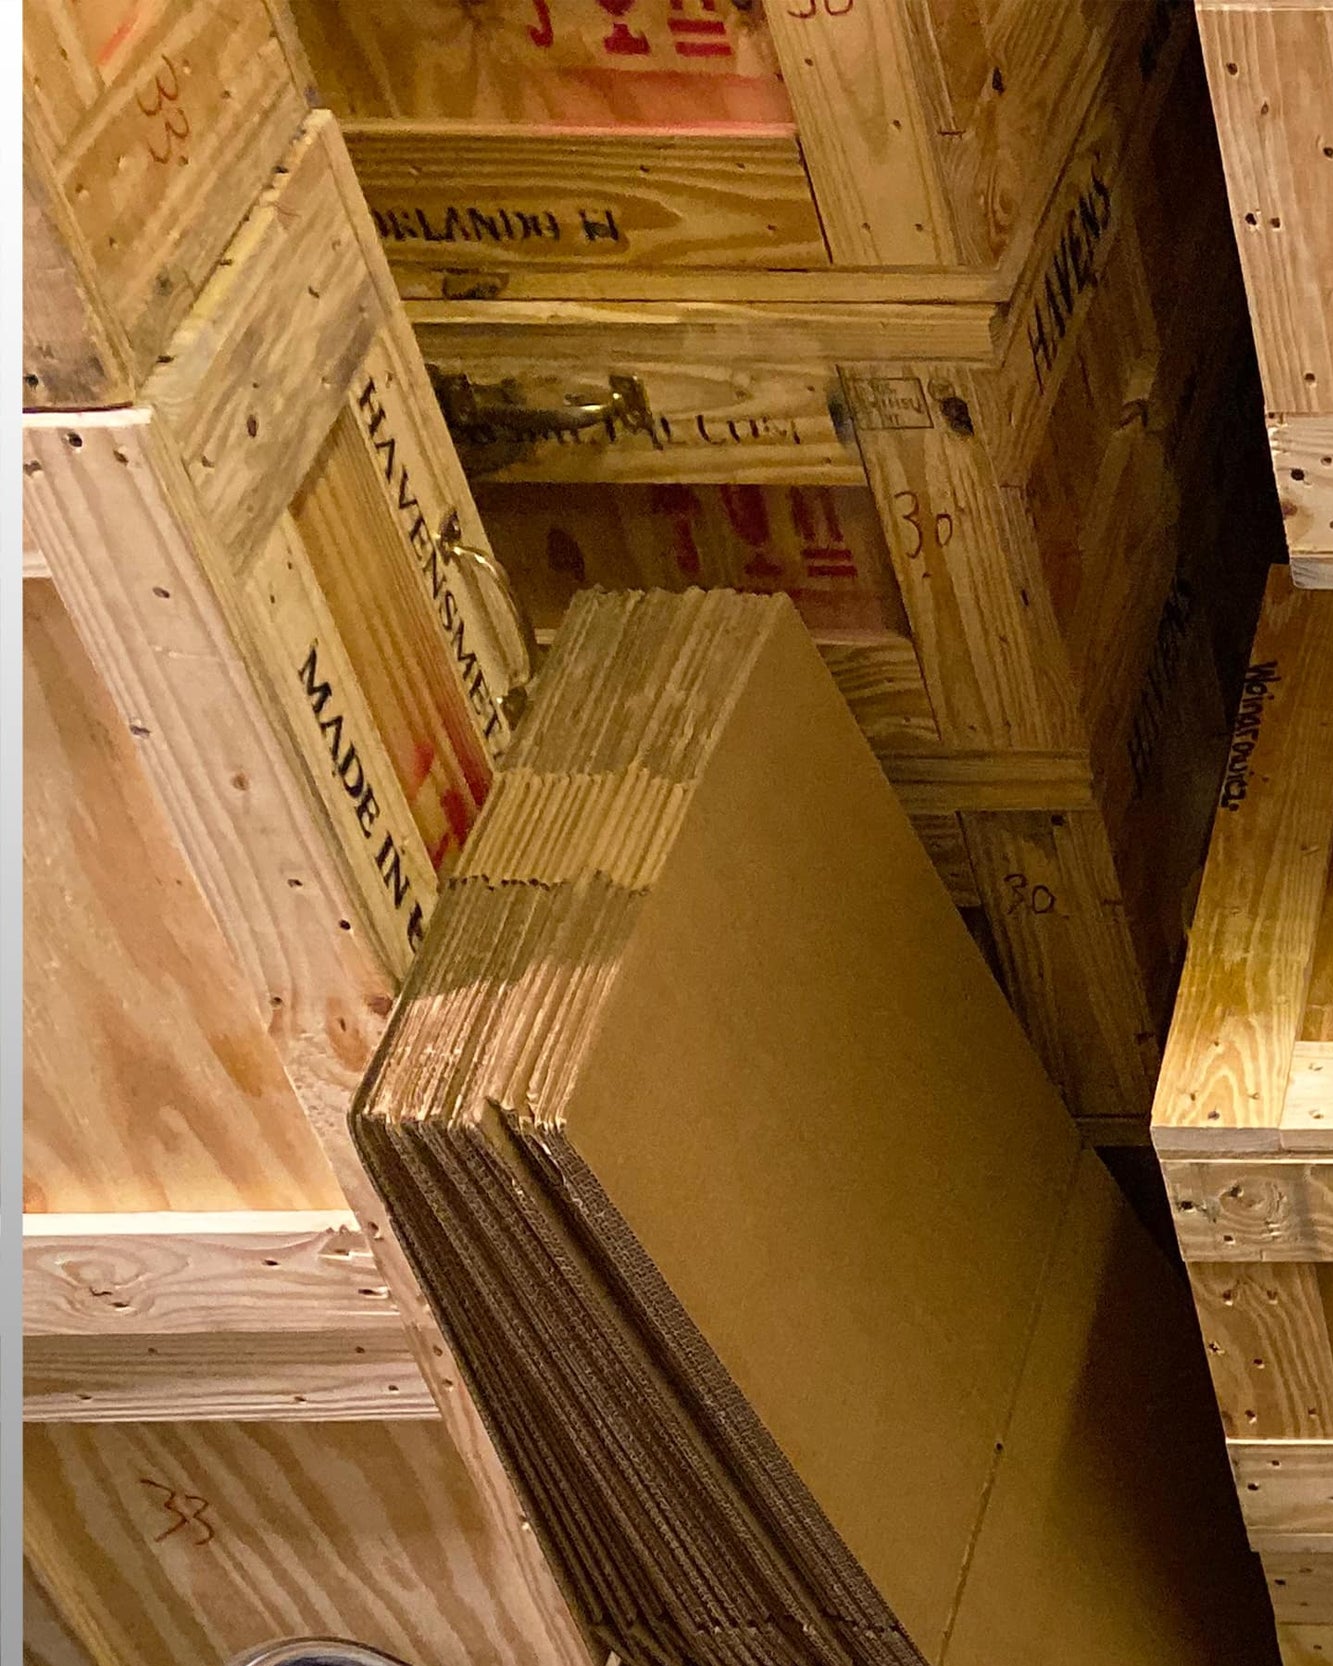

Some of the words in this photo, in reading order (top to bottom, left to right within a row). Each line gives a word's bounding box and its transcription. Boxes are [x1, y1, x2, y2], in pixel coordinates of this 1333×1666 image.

[893, 490, 953, 559] 30
[298, 643, 381, 840] MADE
[375, 830, 411, 911] IN
